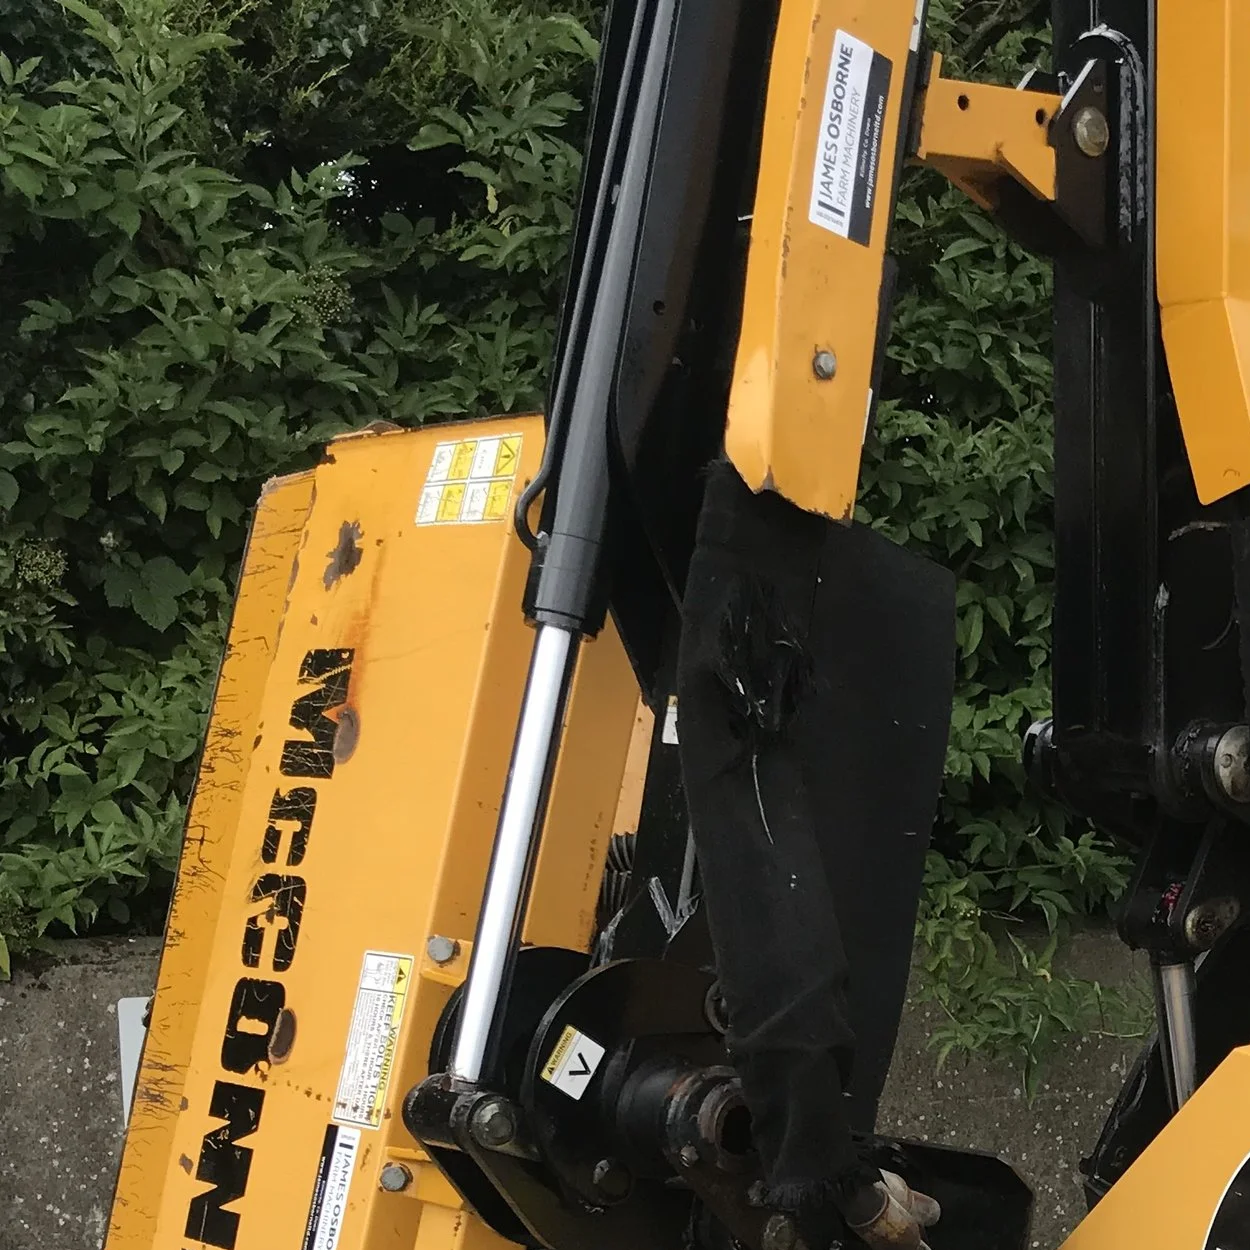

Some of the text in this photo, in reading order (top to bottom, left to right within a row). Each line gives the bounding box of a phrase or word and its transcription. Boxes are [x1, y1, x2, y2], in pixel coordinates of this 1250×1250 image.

[826, 41, 853, 142] OSBORNE
[818, 139, 839, 200] JAMES
[836, 86, 861, 207] FARM MACHINERY
[378, 993, 387, 1020] CHECK
[382, 994, 395, 1031] KEEP
[372, 1034, 387, 1079] BOLTS
[377, 1026, 397, 1090] WARNING
[551, 1032, 572, 1066] WARNING
[330, 1151, 342, 1182] FARM
[335, 1153, 352, 1201] JAMES
[316, 1185, 335, 1250] MACHINERY
